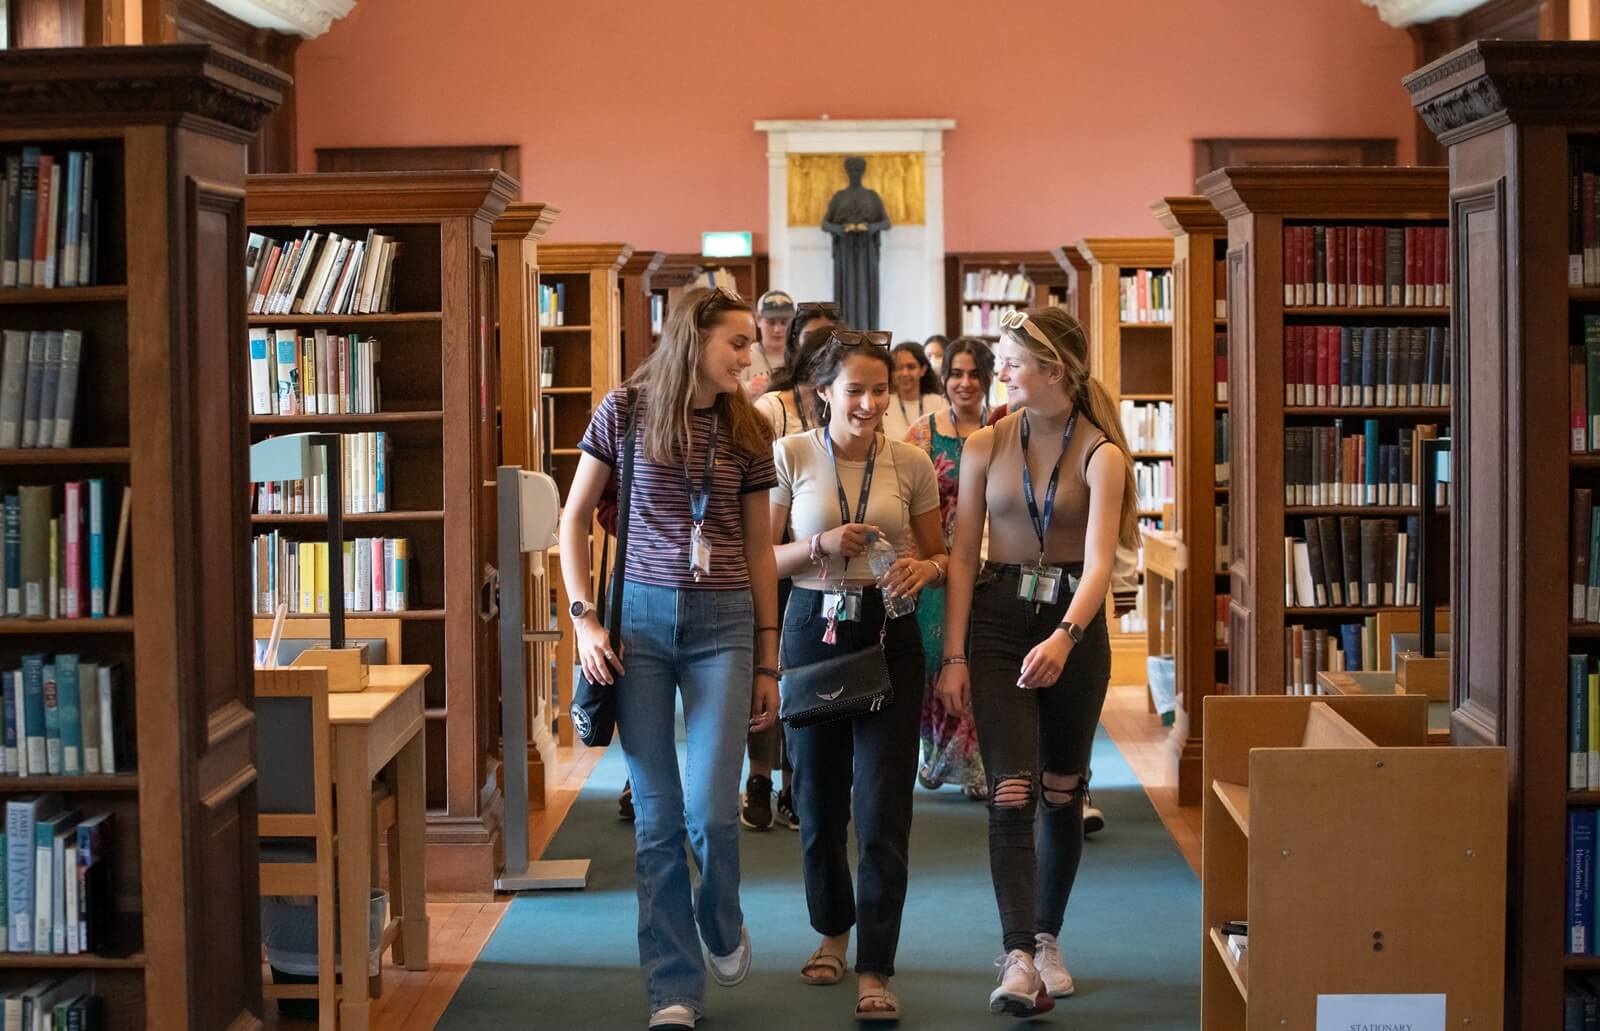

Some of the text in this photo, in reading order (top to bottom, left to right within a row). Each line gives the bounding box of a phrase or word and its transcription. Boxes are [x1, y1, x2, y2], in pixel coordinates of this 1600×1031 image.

[19, 809, 27, 838] JAMES
[1575, 849, 1583, 888] Herodotus
[1349, 1023, 1413, 1031] STATIONARY
